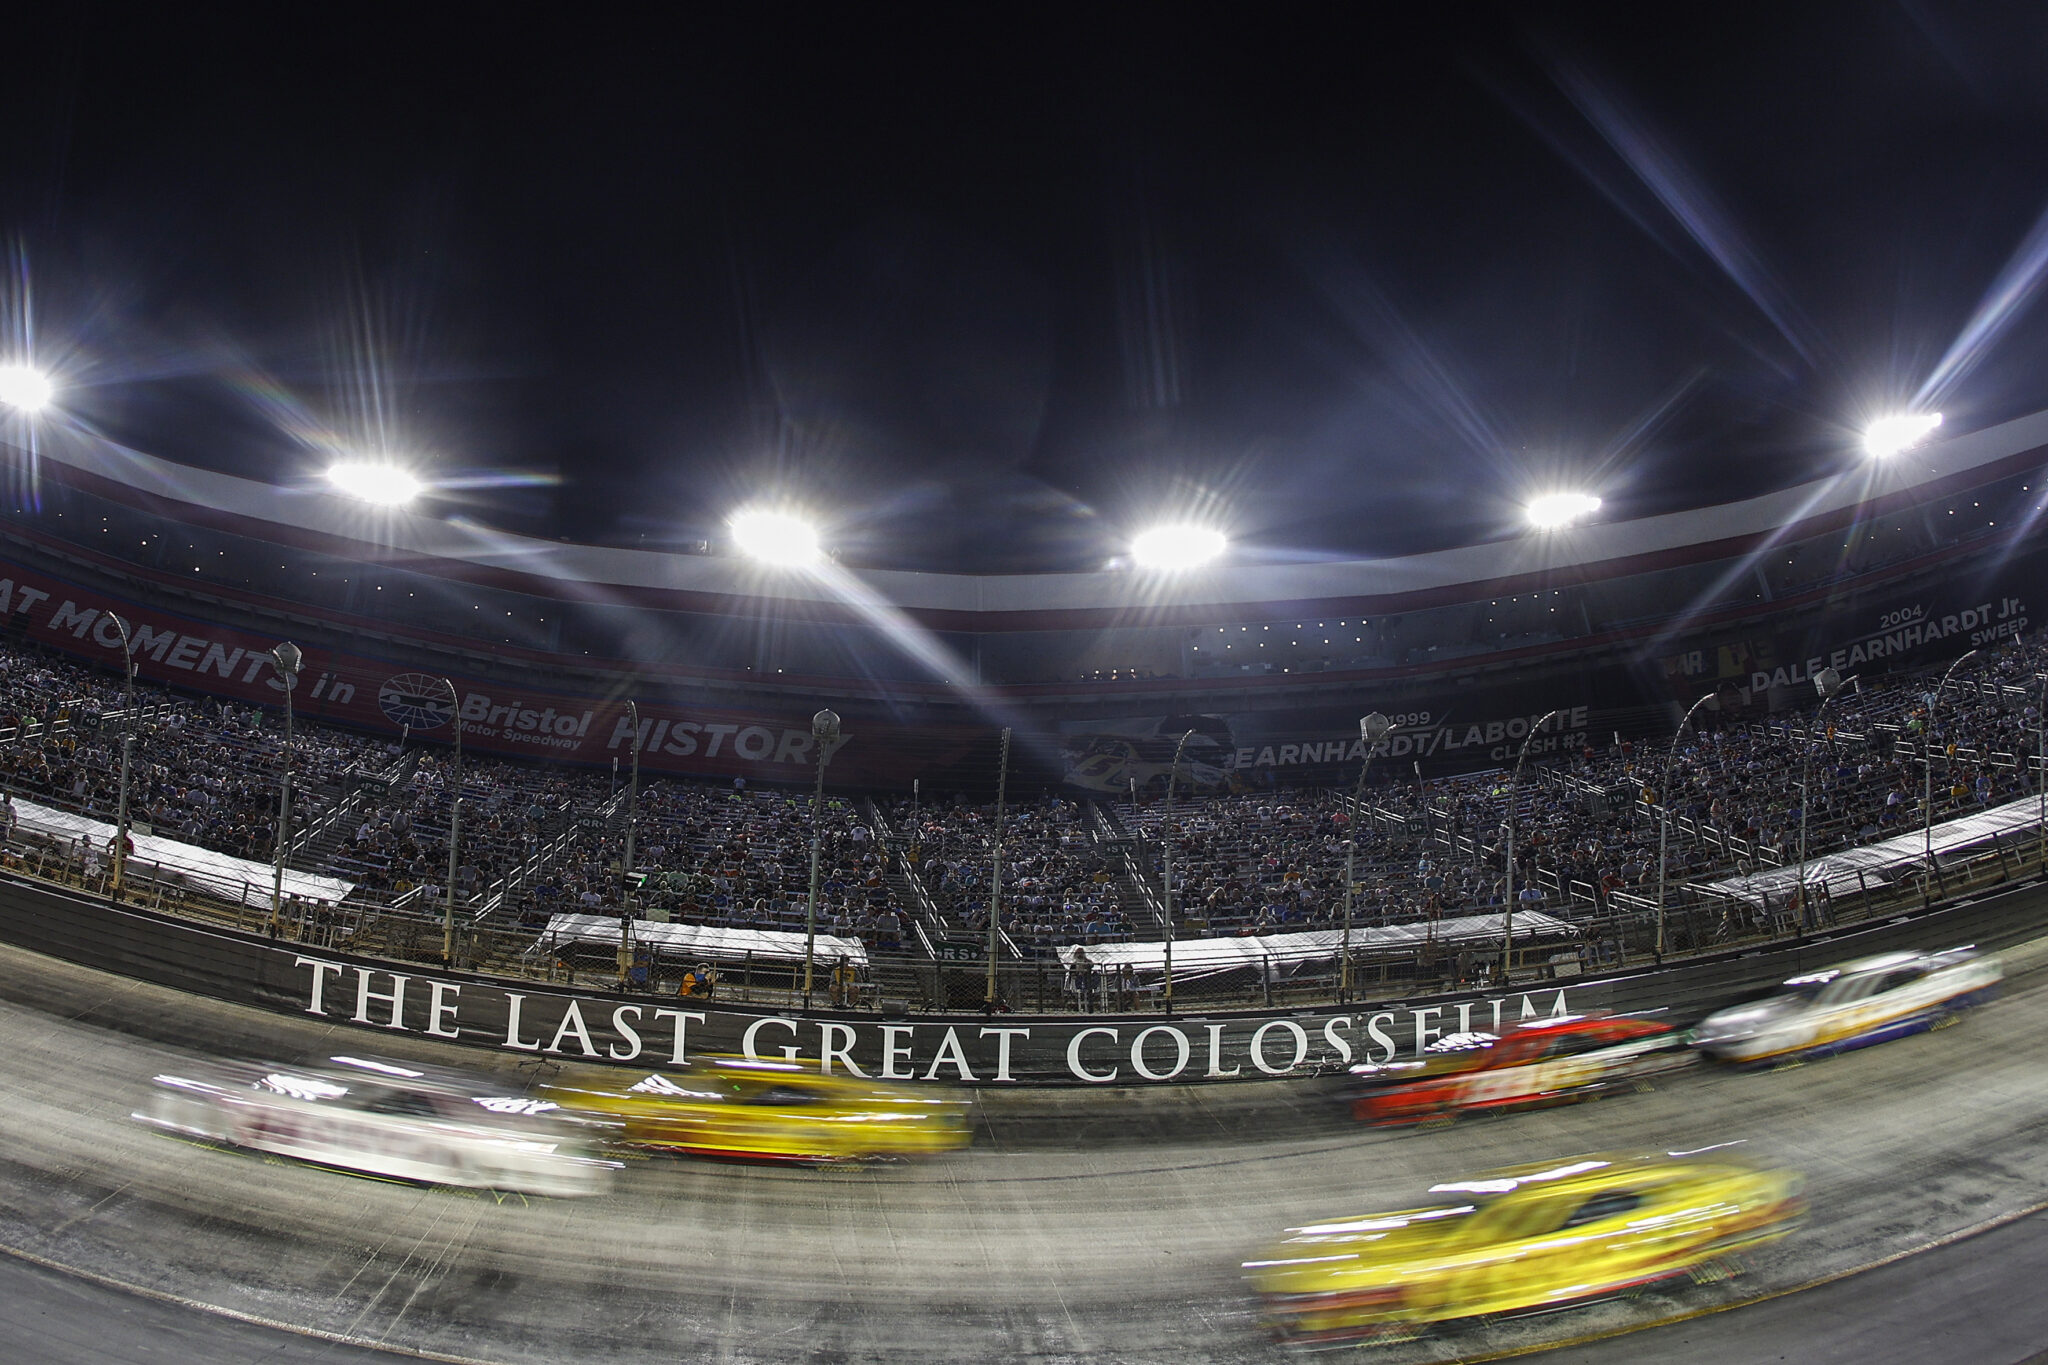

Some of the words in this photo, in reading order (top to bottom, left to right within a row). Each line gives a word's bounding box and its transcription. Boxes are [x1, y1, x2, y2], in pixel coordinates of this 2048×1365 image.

[1880, 604, 1923, 628] 2004
[1970, 617, 2029, 648] SWEEP
[48, 600, 306, 692] MOMENTS
[310, 672, 355, 704] in
[1752, 656, 1822, 693] DALE
[1830, 604, 1993, 671] EARNHARDT
[1998, 597, 2027, 621] Jr.
[459, 693, 593, 737] Bristol
[1388, 711, 1431, 728] 1999
[502, 728, 582, 750] Speedway
[607, 716, 854, 766] HISTORY
[1490, 735, 1557, 761] CLASH
[294, 956, 462, 1039] THE
[502, 993, 706, 1065] LAST
[742, 1018, 1030, 1082] GREAT
